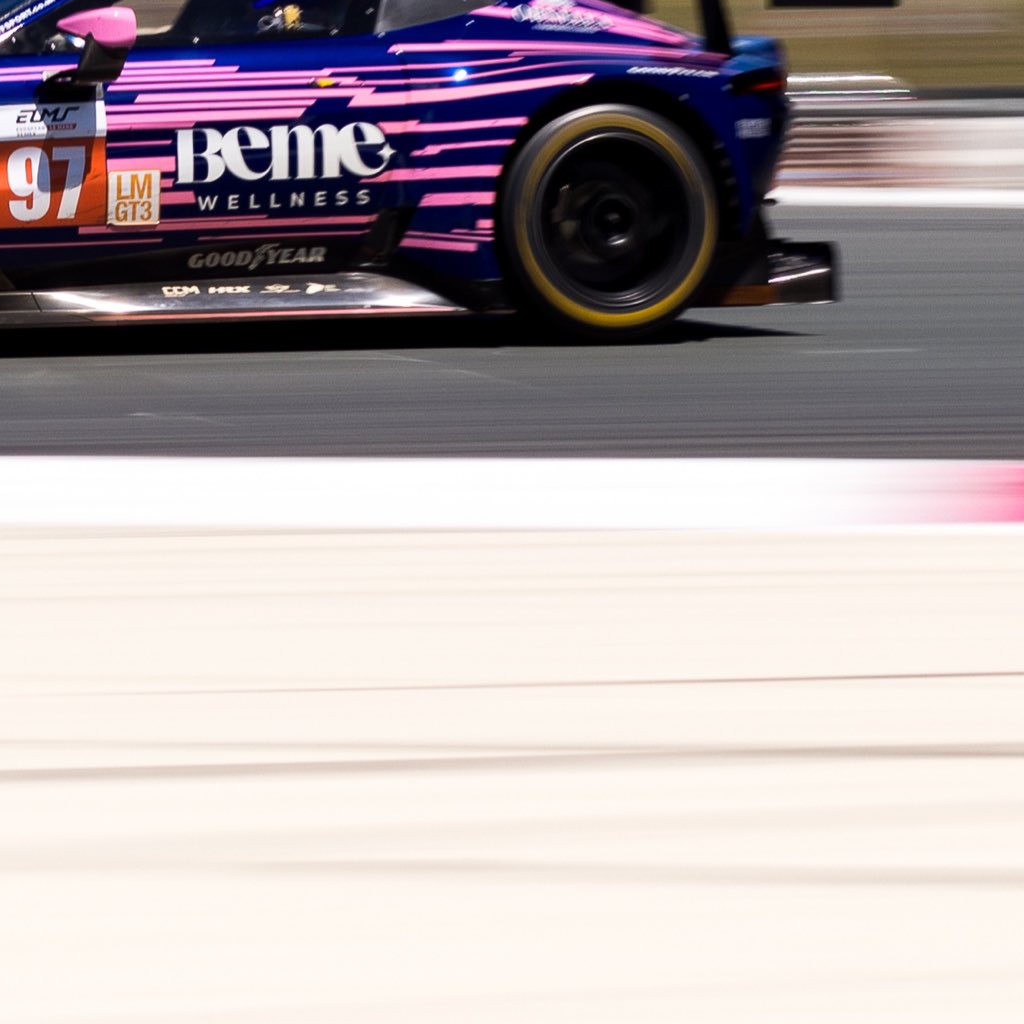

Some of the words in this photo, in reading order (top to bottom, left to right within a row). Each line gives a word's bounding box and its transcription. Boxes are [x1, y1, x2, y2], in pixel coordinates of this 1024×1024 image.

[16, 106, 80, 123] ELMS
[6, 145, 86, 223] 97
[116, 173, 152, 201] LM
[114, 199, 153, 223] GT3
[197, 188, 371, 212] WELLNESS
[187, 242, 328, 272] GOODYEAR
